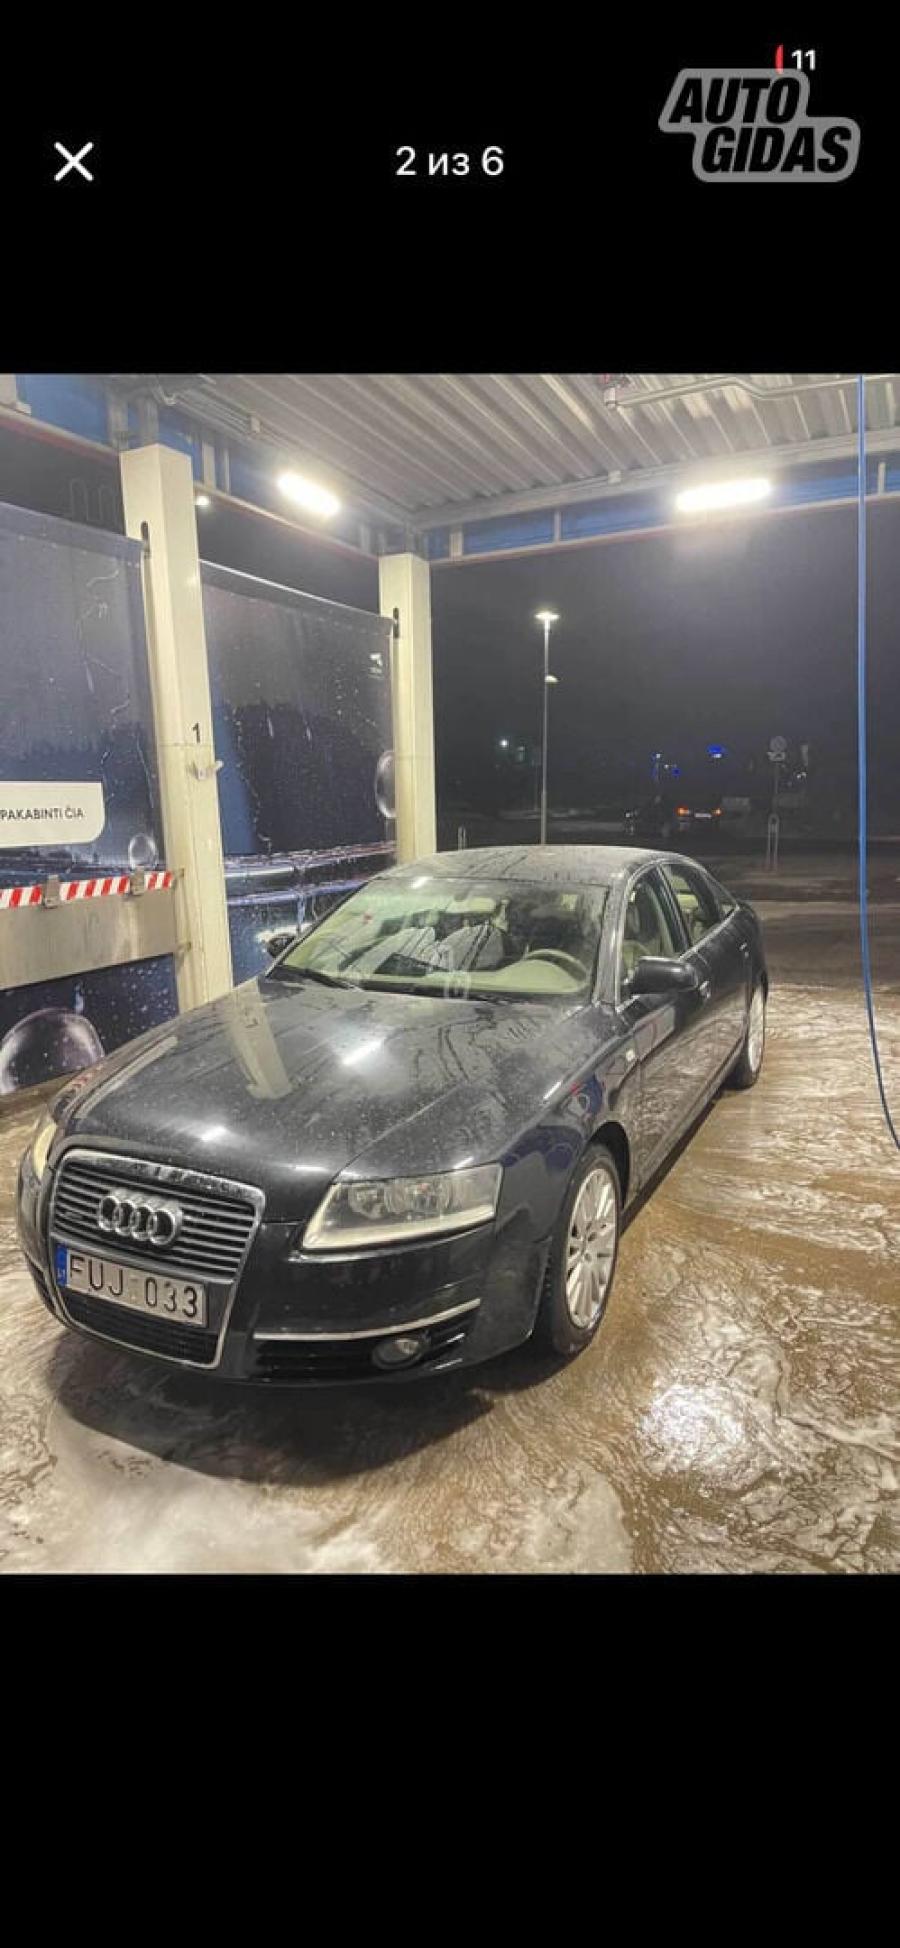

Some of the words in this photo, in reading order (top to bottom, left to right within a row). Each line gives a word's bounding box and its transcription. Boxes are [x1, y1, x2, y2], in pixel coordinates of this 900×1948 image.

[192, 722, 201, 744] 1
[0, 807, 63, 821] PAKABINTI
[69, 1254, 124, 1297] FUJ
[145, 1276, 198, 1318] 033
